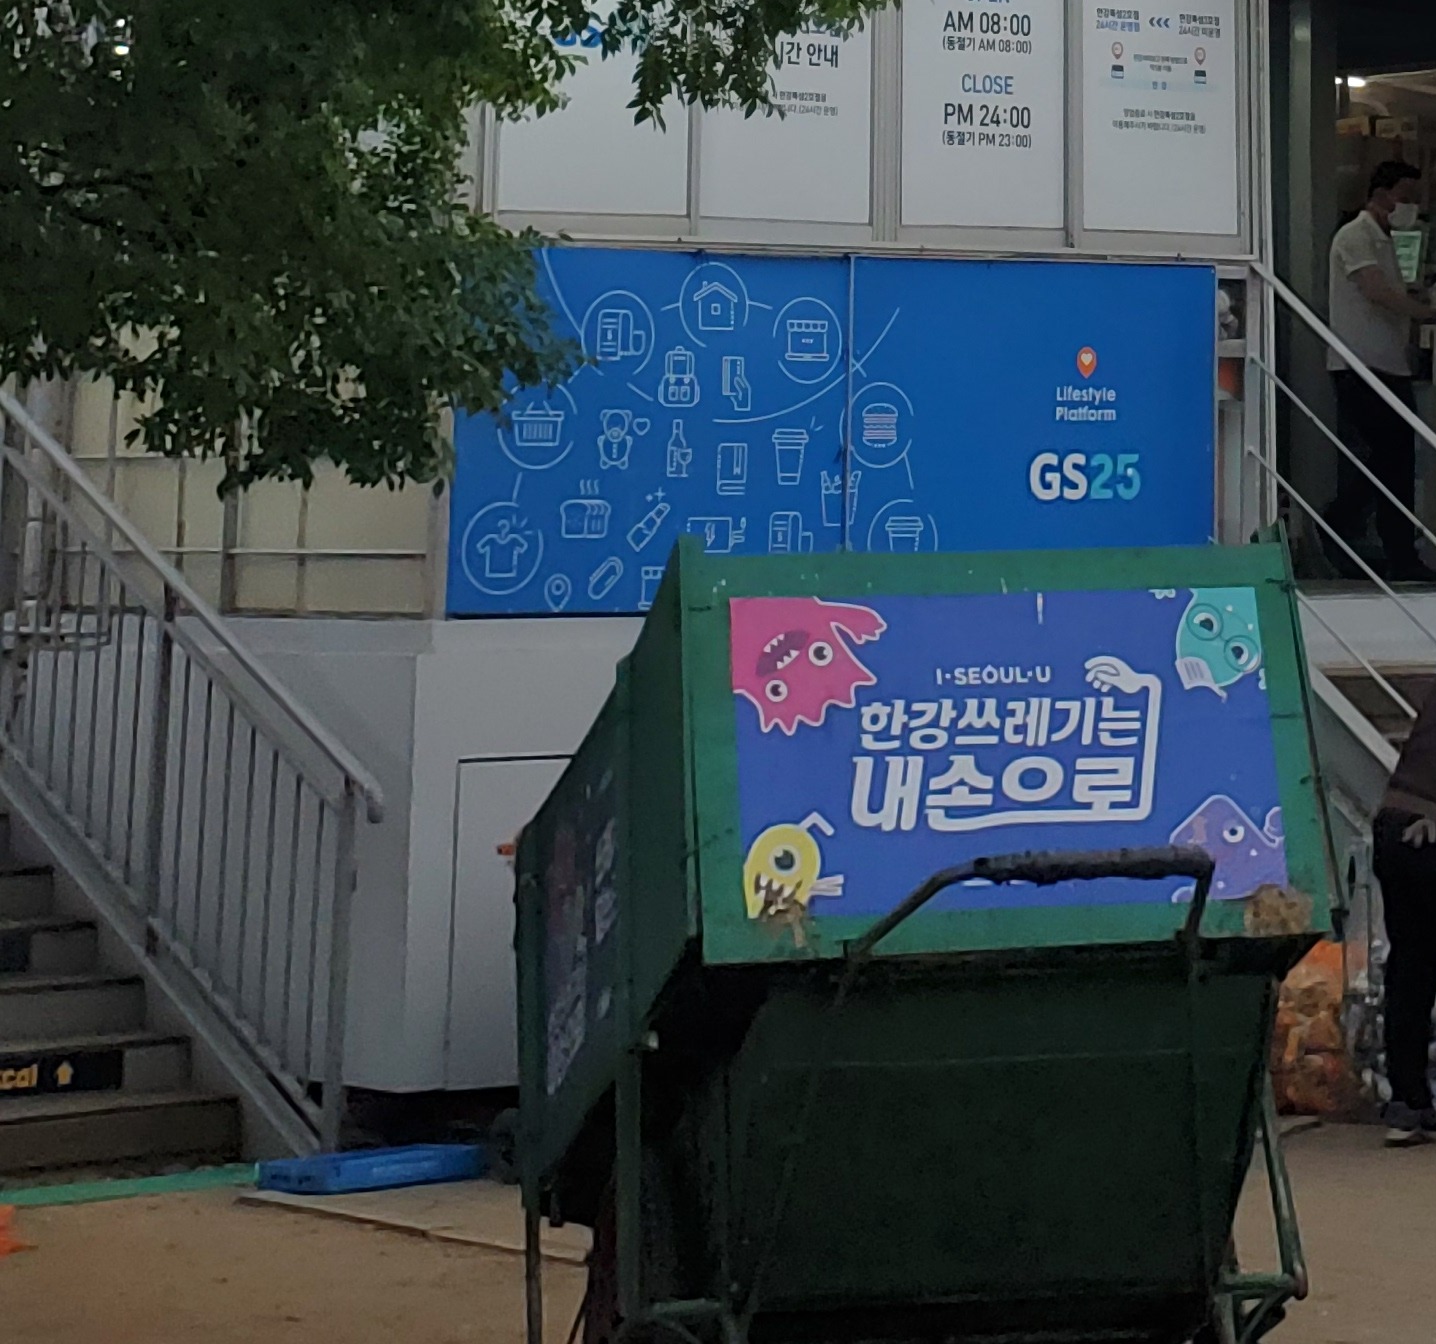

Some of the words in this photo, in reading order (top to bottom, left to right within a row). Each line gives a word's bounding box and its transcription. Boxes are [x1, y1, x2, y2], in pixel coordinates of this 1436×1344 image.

[943, 10, 974, 33] AM
[979, 11, 1031, 37] 08:00
[806, 42, 839, 68] 안내
[942, 35, 976, 52] (동절기
[978, 37, 996, 52] AM
[998, 38, 1032, 55] 08:00)
[961, 73, 1014, 95] CLOSE
[943, 103, 974, 127] PM
[979, 104, 1031, 129] 24:00
[942, 129, 976, 146] (동절기
[978, 131, 996, 147] PM
[998, 132, 1032, 149] 23:00)
[1055, 385, 1117, 406] Lifestyle
[1055, 405, 1117, 422] Platform
[1029, 452, 1141, 501] GS25
